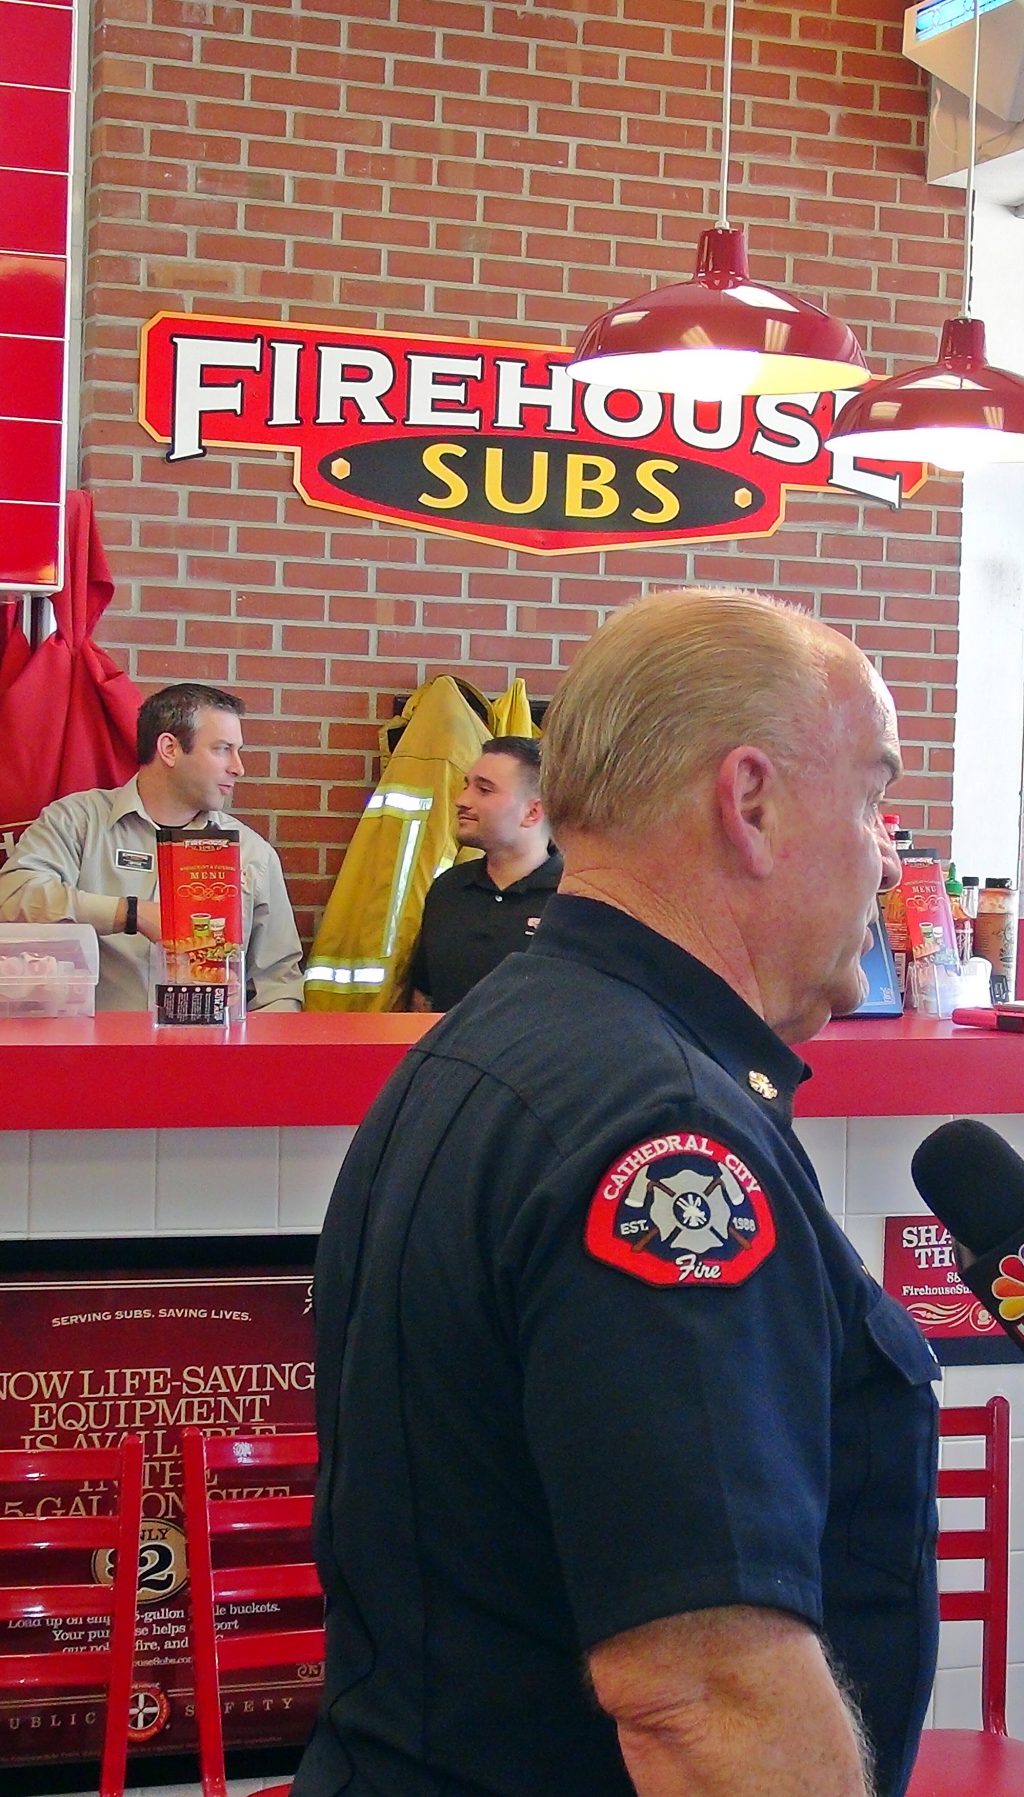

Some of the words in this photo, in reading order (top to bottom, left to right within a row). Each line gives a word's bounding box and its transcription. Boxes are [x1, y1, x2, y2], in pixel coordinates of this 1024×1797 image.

[418, 443, 680, 525] SUBS
[190, 872, 225, 880] MENU
[912, 885, 937, 894] MENU
[603, 1135, 714, 1200] CATHEDRAL
[724, 1154, 762, 1193] CITY
[620, 1220, 649, 1235] EST.
[675, 1253, 722, 1281] Fire
[902, 1284, 973, 1297] FirehouseSu
[51, 1311, 112, 1328] SERVING
[114, 1308, 156, 1320] SUBS.
[158, 1307, 208, 1319] SAVING
[211, 1309, 252, 1322] LIVES.
[78, 1361, 316, 1399] LIFE-SAVING
[29, 1394, 271, 1432] EQUIPMENT
[229, 1602, 281, 1615] buckets.
[52, 1630, 85, 1641] Your
[152, 1623, 186, 1637] helps
[134, 1640, 161, 1652] fire,
[164, 1637, 189, 1649] and
[185, 1697, 293, 1717] SFETY
